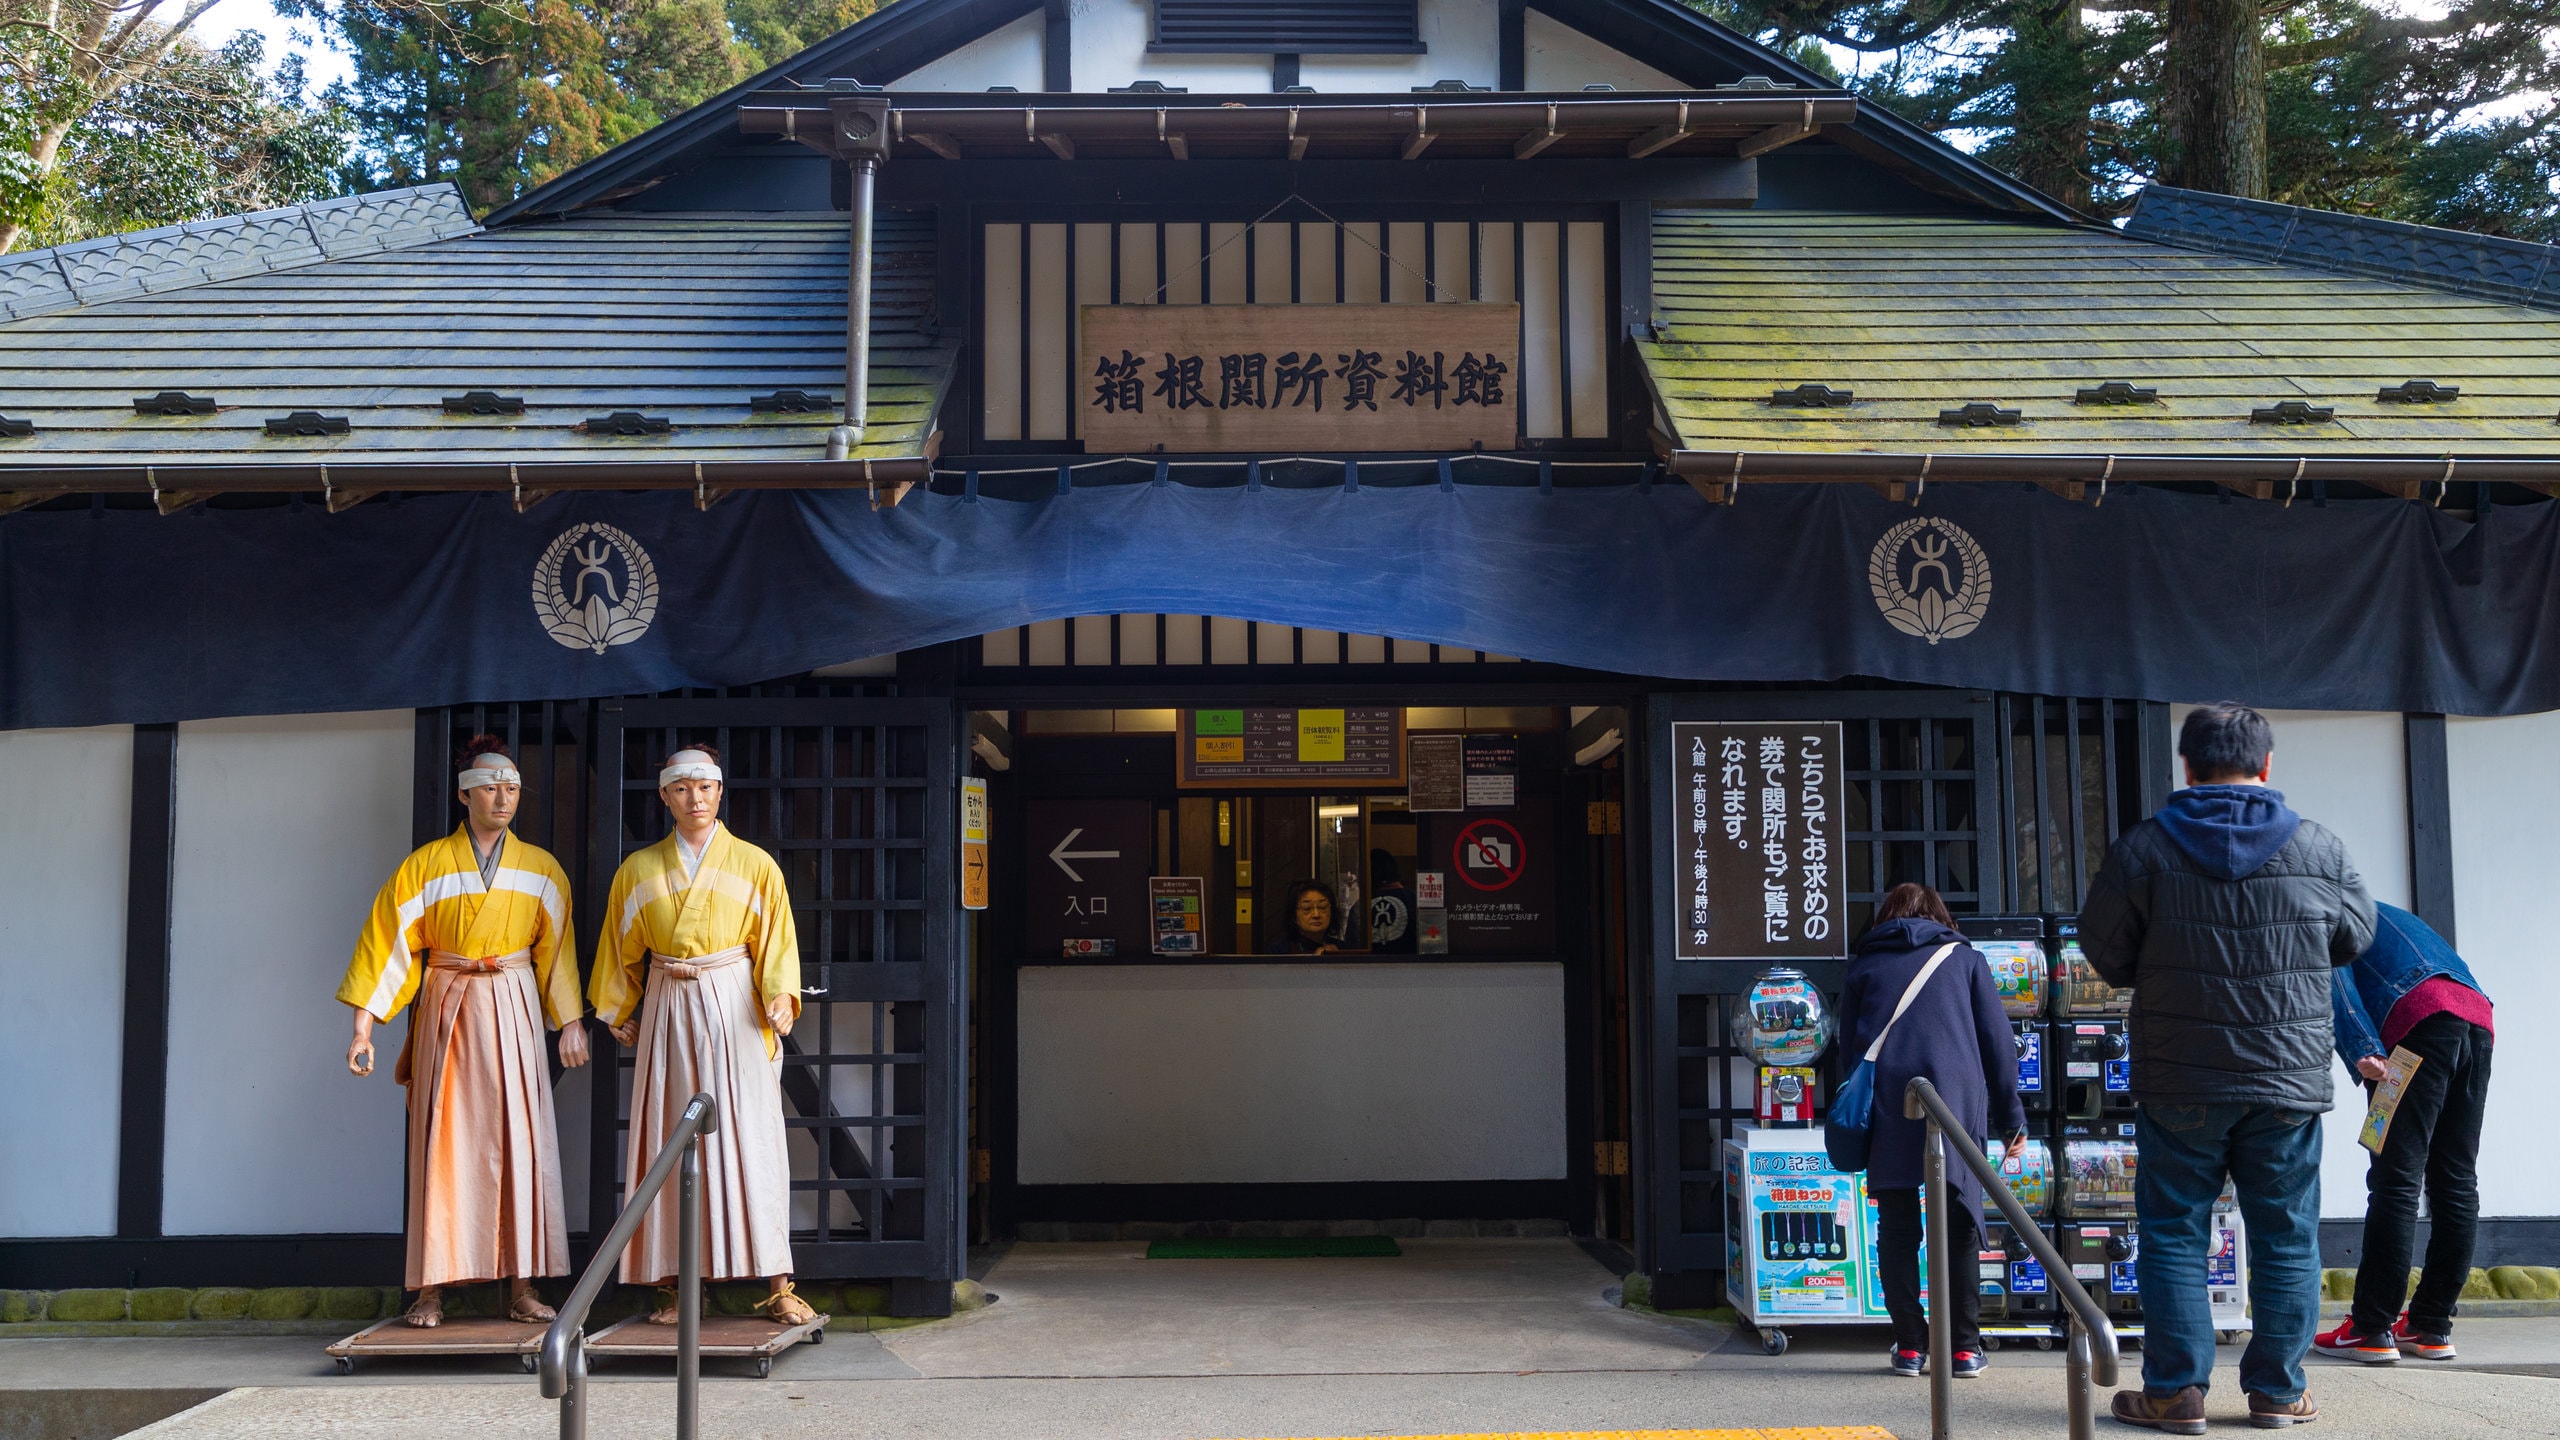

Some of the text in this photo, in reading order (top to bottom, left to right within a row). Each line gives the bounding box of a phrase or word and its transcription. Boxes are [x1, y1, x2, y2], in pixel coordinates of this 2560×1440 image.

[1092, 349, 1508, 414] 箱根関所資料館
[1721, 736, 1748, 850] なれます。
[1759, 736, 1790, 943] 券で関所もご覧に
[1800, 735, 1830, 940] こちらでお求めの
[1064, 895, 1108, 916] 入口
[1447, 912, 1540, 921] 内は撮影禁止となっております
[1770, 1188, 1833, 1202] 箱根ねつけ
